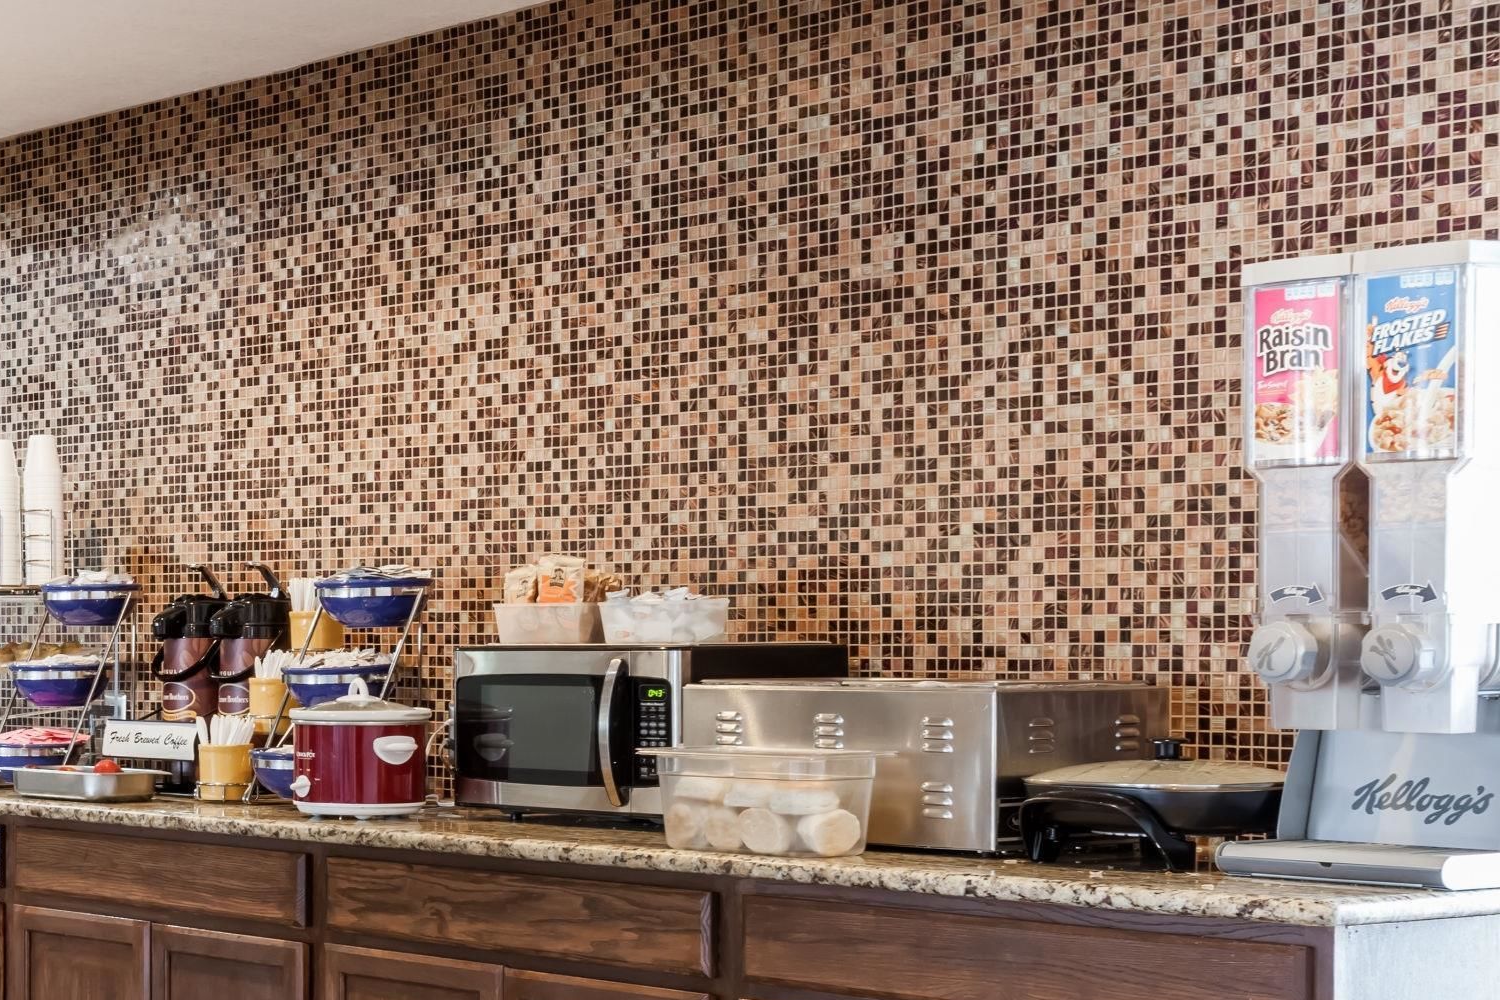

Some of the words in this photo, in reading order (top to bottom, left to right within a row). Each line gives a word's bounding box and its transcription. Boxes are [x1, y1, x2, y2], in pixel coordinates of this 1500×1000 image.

[1258, 325, 1330, 355] Raisin
[1372, 309, 1447, 342] FROSTED
[1372, 326, 1436, 356] FLAKES
[1264, 348, 1321, 374] Bran
[109, 730, 131, 745] Fresh
[134, 731, 161, 745] Brewed
[163, 732, 189, 750] Coffee
[1351, 773, 1495, 826] Kellogg's
